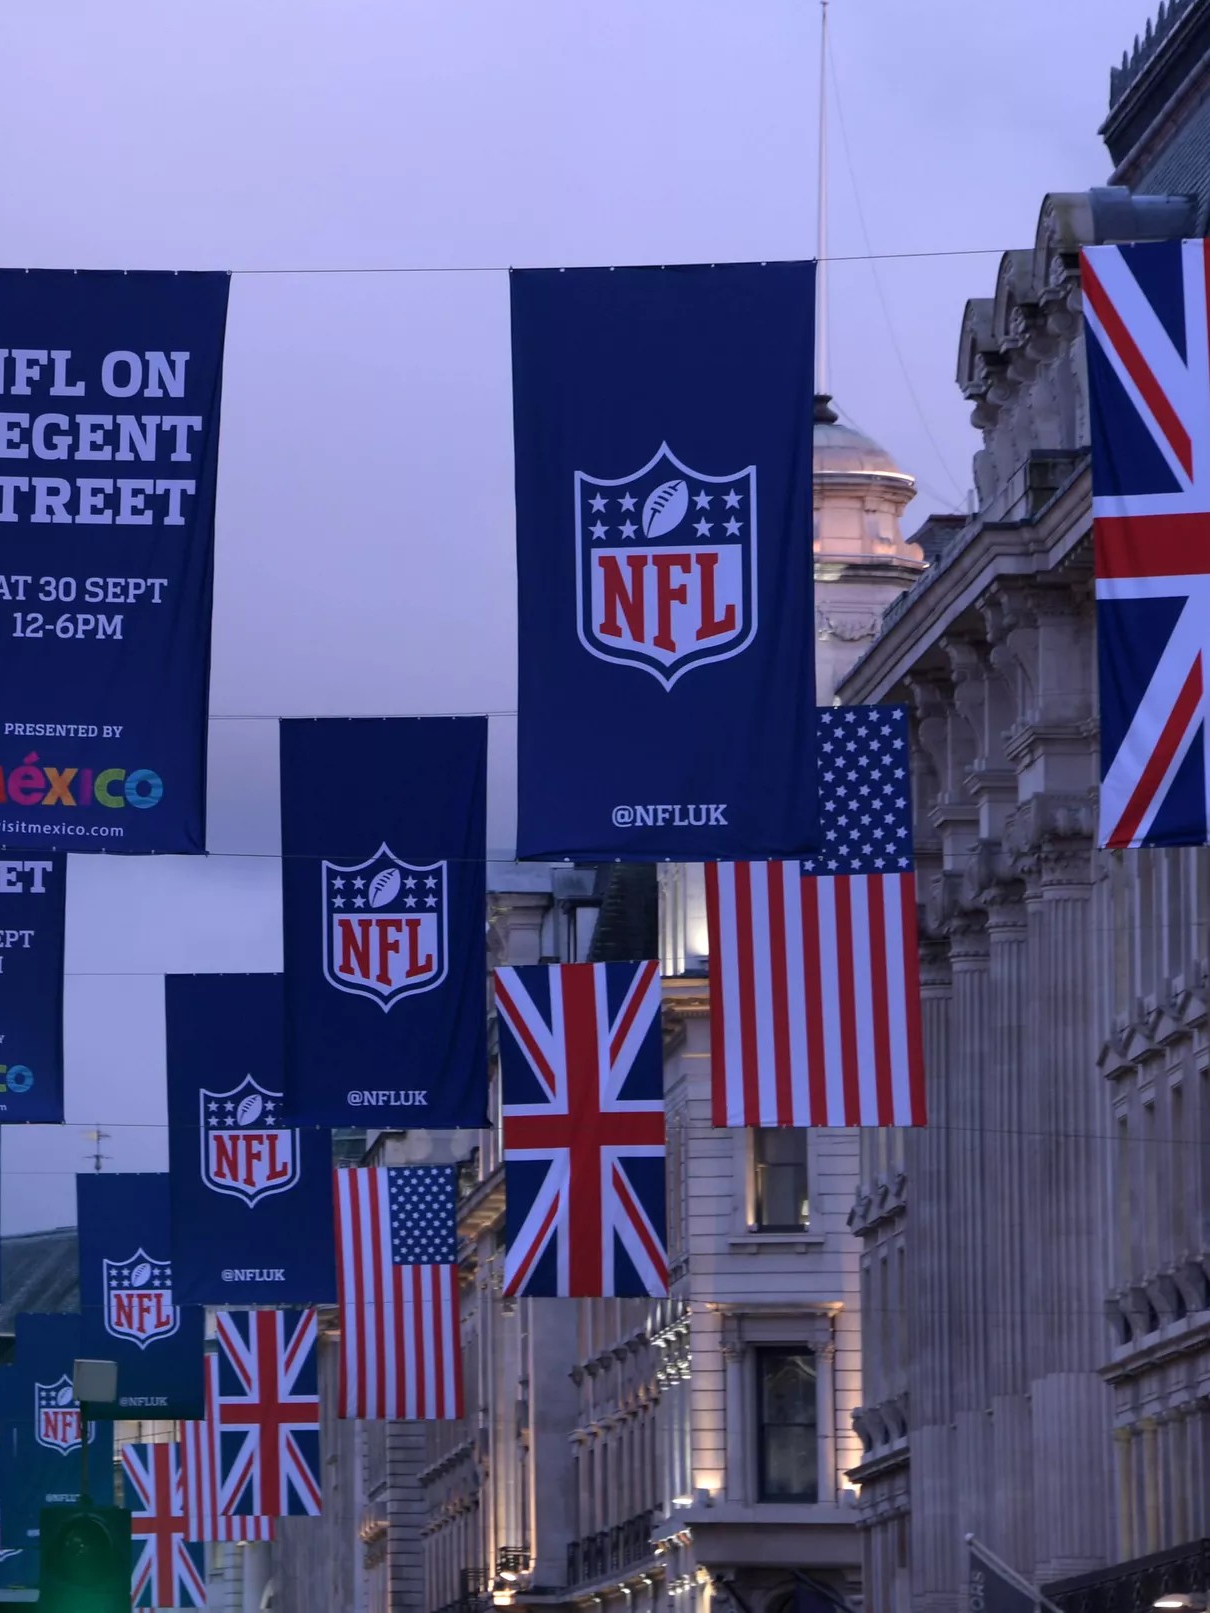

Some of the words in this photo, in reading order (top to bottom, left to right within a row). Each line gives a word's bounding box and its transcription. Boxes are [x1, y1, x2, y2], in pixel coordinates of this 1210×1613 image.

[100, 350, 190, 398] ON
[38, 575, 77, 603] 30
[84, 577, 168, 604] SEPT
[597, 552, 736, 654] NFL
[12, 611, 124, 640] 12-6PM
[4, 722, 98, 738] PRESENTED
[102, 724, 124, 739] BY
[611, 803, 728, 828] @NFLUK
[338, 918, 433, 987] NFL
[347, 1090, 428, 1106] @NFLUK
[213, 1134, 288, 1187] NFL
[221, 1268, 285, 1282] @NFLUK
[114, 1293, 170, 1334] NFL
[119, 1396, 168, 1407] @NFLUK
